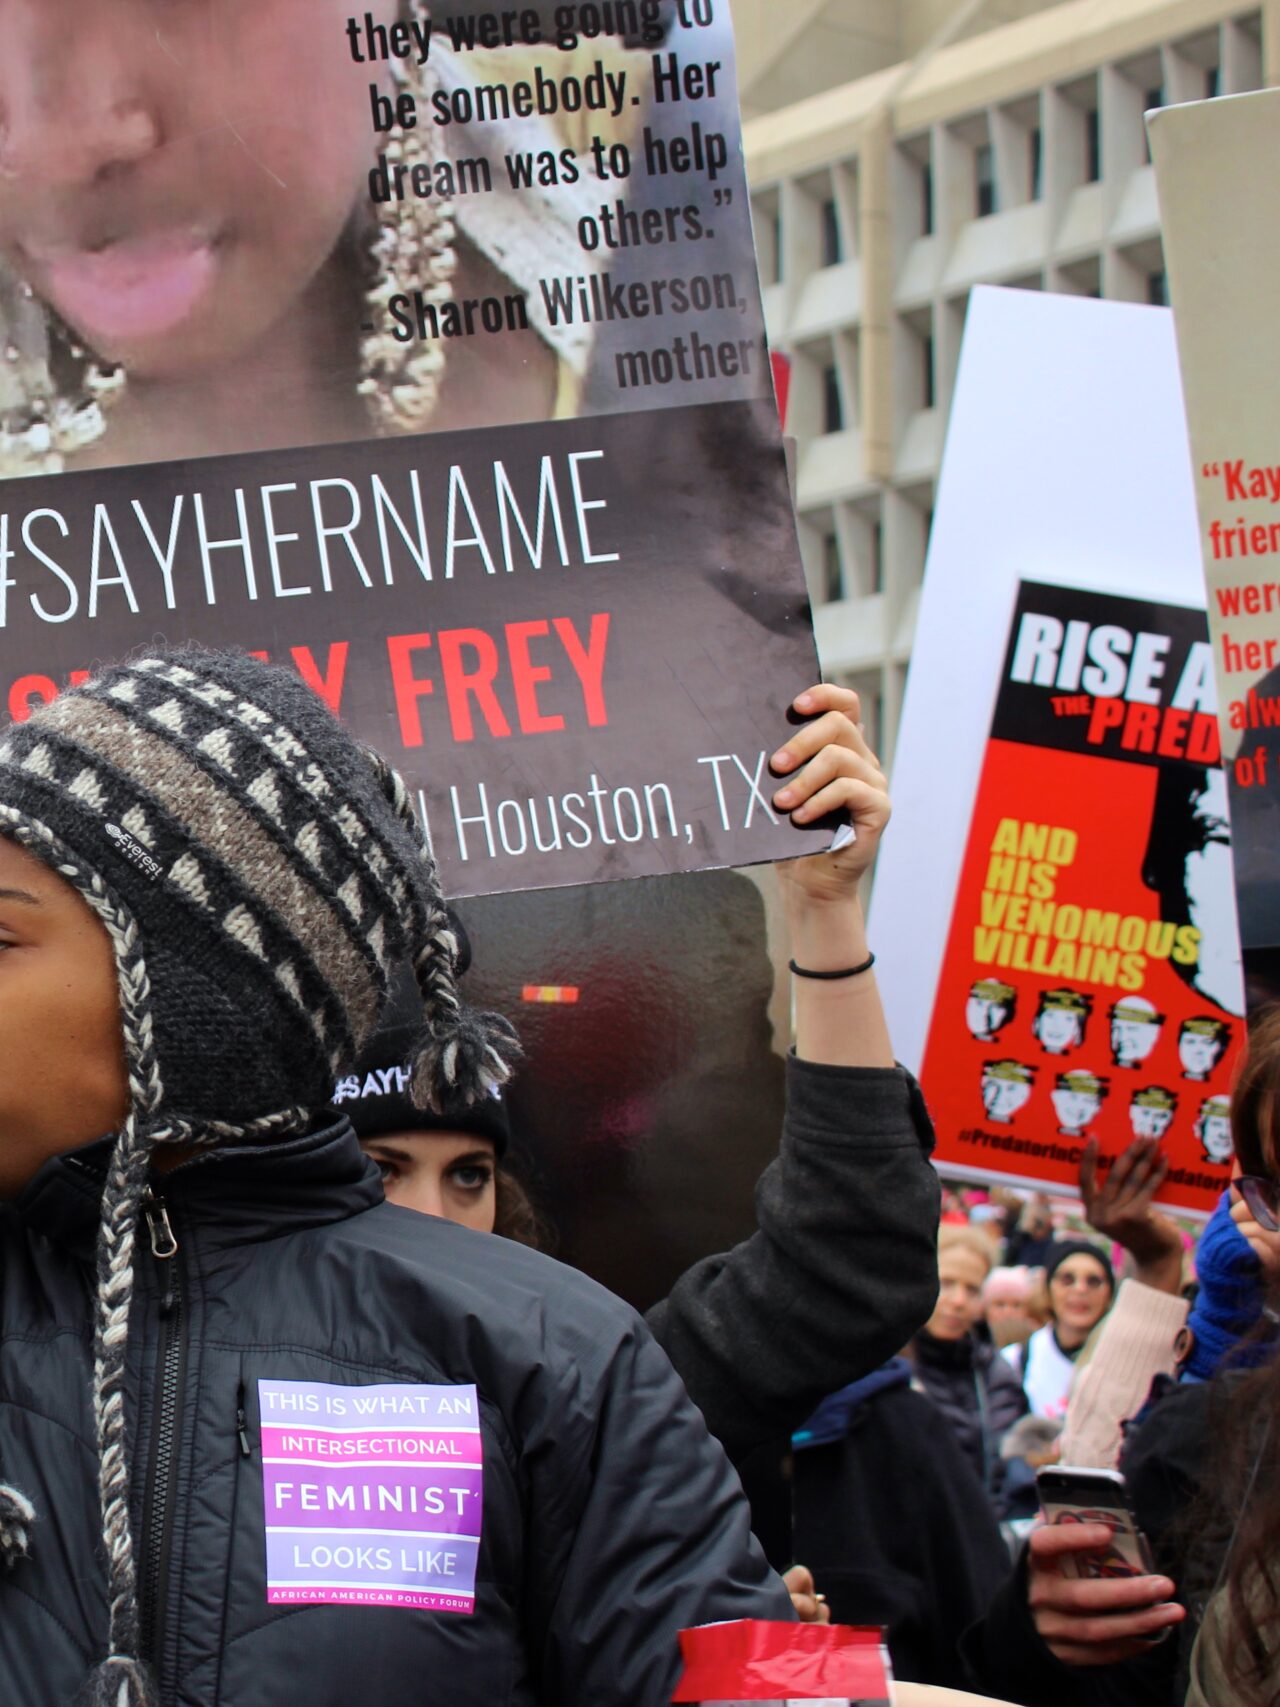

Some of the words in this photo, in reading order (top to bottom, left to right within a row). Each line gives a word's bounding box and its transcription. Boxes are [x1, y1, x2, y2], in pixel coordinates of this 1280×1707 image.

[345, 12, 432, 66] they
[446, 13, 541, 52] were
[554, 0, 666, 52] going
[677, 0, 714, 29] to
[369, 83, 417, 133] be
[431, 60, 641, 128] somebody.
[651, 52, 722, 104] Her
[368, 153, 493, 203] dream
[504, 147, 580, 190] was
[591, 136, 631, 181] to
[644, 122, 729, 181] help
[387, 291, 529, 342] Sharon
[539, 271, 748, 327] Wilkerson,
[614, 331, 755, 389] mother
[1216, 581, 1280, 619] wer
[1009, 612, 1172, 706] RISE
[1222, 632, 1277, 674] her
[386, 612, 611, 749] FREY
[1050, 695, 1092, 717] THE
[1086, 696, 1222, 765] PRED
[1234, 746, 1267, 788] of
[449, 774, 694, 862] Houston,
[696, 750, 781, 832] TX
[119, 834, 164, 878] Everest
[990, 817, 1078, 867] AND
[984, 855, 1058, 900] HIS
[980, 891, 1202, 966] VENOMOUS
[972, 925, 1147, 991] VILLAINS
[958, 1128, 1117, 1170] #PredatorInCef
[263, 1391, 319, 1413] THIS
[326, 1396, 347, 1417] IS
[353, 1395, 430, 1415] WHAT
[437, 1396, 472, 1415] AN
[281, 1435, 463, 1456] INTERSECTIONAL
[274, 1482, 471, 1516] FEMINIST
[293, 1545, 393, 1571] LOOKS
[401, 1549, 458, 1577] LIKE
[272, 1590, 326, 1600] AFRICAN
[331, 1590, 393, 1602] AMERICAN
[397, 1593, 437, 1606] POLICY
[439, 1597, 471, 1609] FORUM
